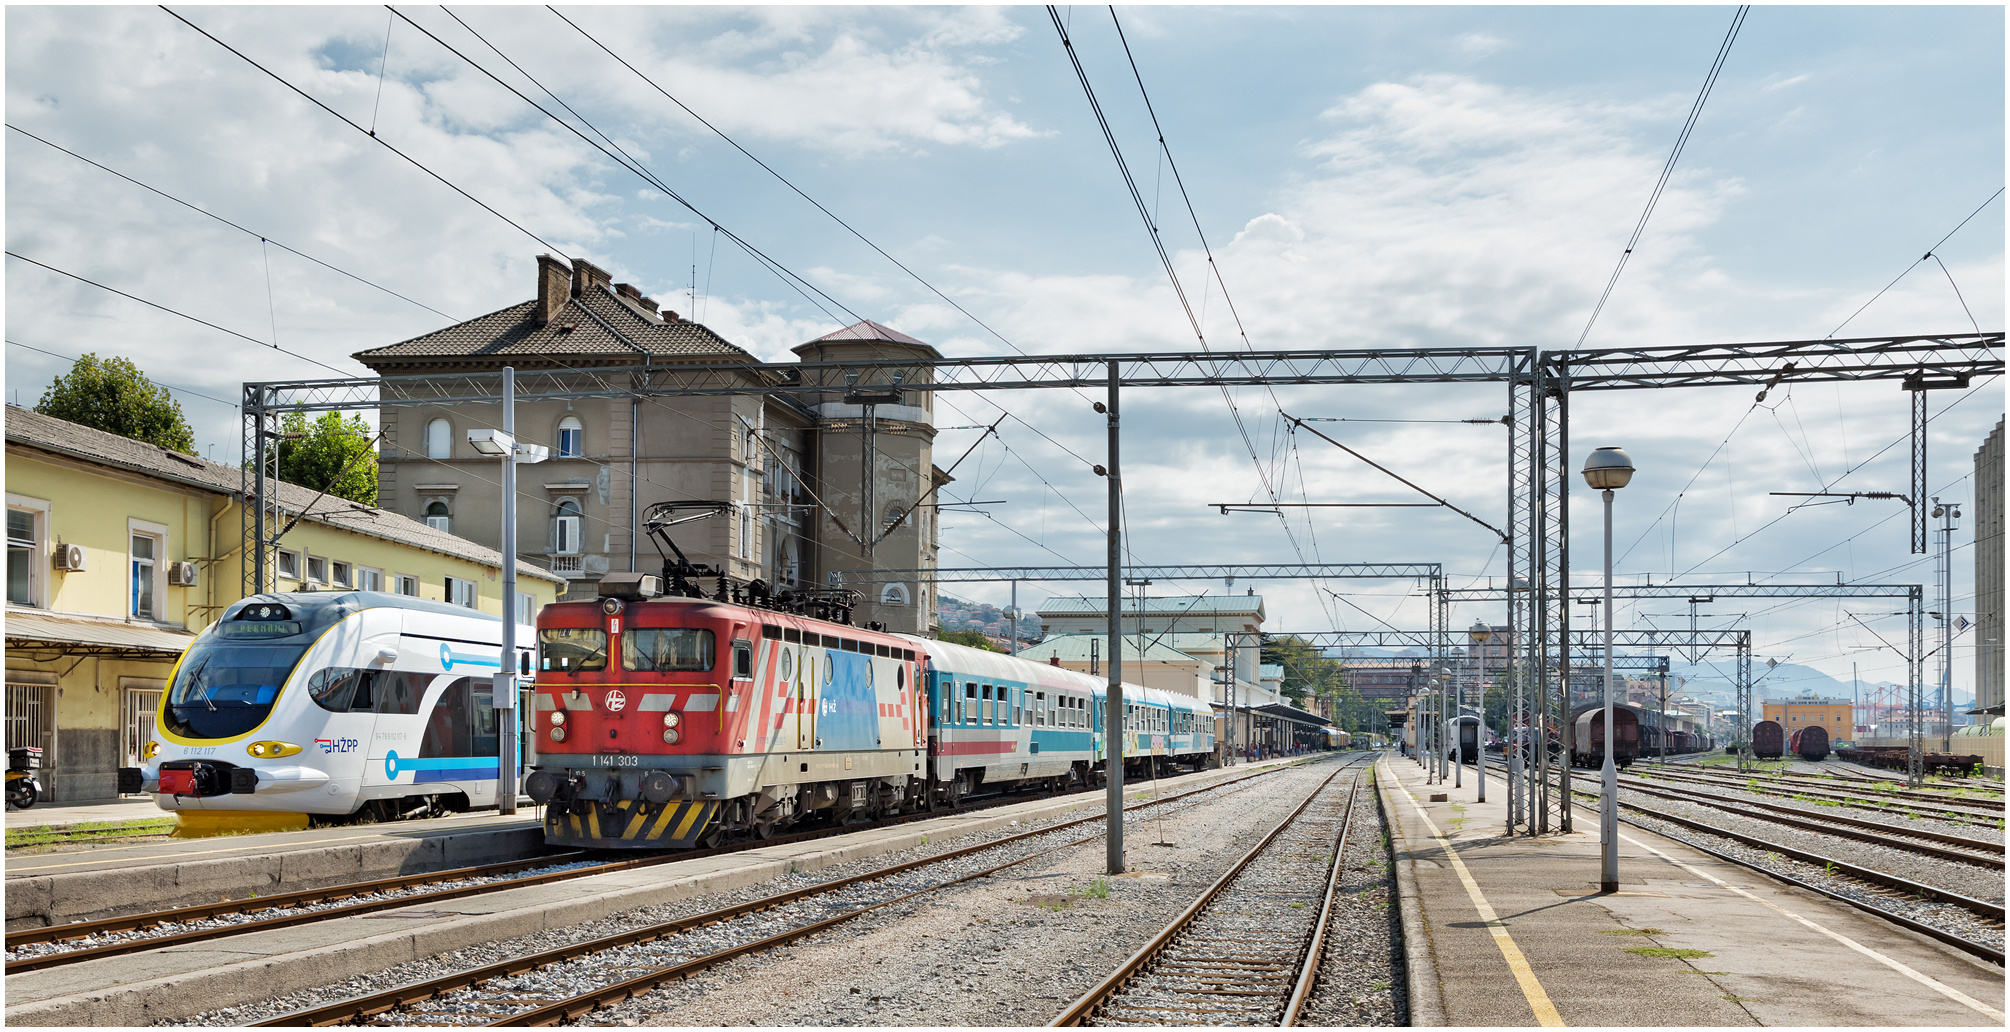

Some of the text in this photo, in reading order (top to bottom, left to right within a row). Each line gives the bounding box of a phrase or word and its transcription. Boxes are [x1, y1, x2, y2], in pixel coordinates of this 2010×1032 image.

[183, 747, 217, 755] 6 112 117
[332, 737, 359, 753] HŽPP
[600, 755, 613, 767] 141
[618, 755, 638, 767] 303
